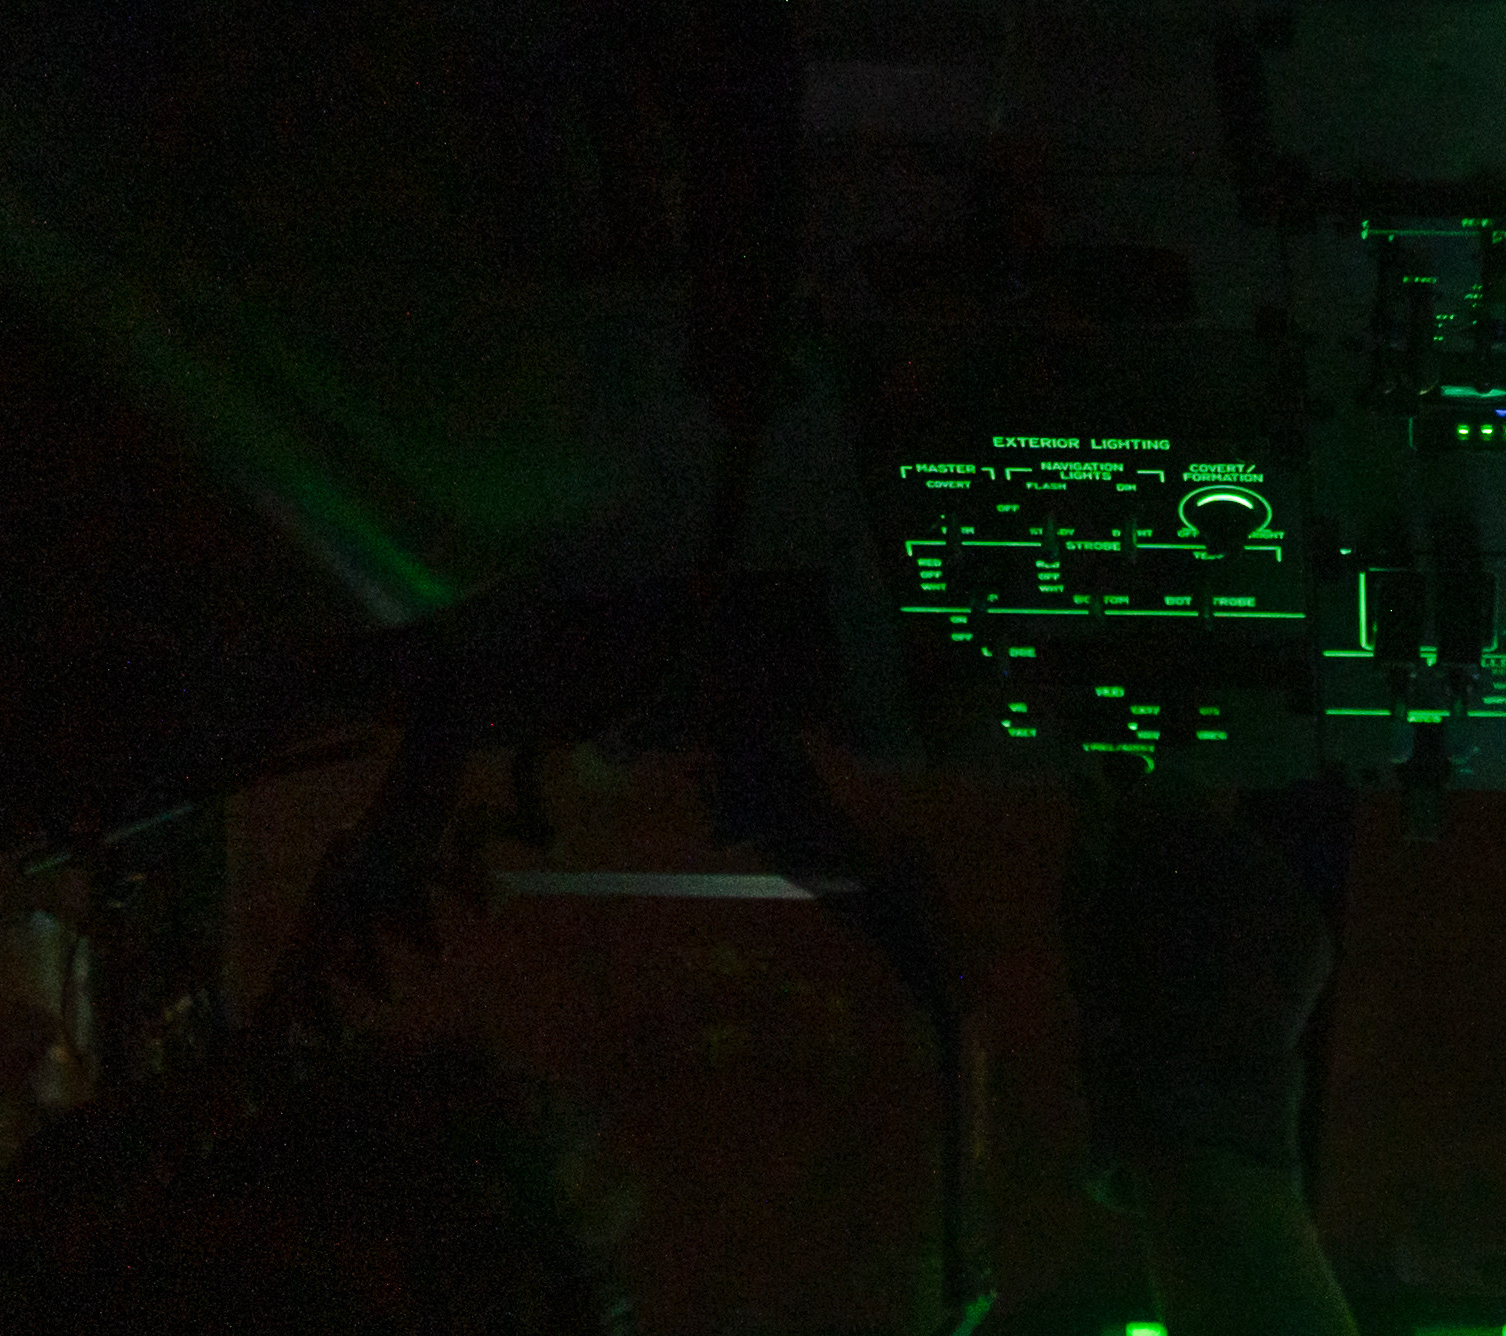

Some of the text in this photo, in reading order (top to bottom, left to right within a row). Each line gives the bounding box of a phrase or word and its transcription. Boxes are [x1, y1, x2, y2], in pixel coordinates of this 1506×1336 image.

[993, 437, 1170, 450] EXTERIOR LIGHTING
[916, 464, 976, 473] MASTER
[1041, 462, 1124, 473] NAVIGATION
[1060, 471, 1111, 480] LIGHTS
[1183, 472, 1263, 482] FORMATION
[926, 480, 970, 488] COVERT
[1026, 482, 1066, 490] FLASH
[1066, 541, 1121, 551] STROBE
[1213, 597, 1255, 607] TROBE
